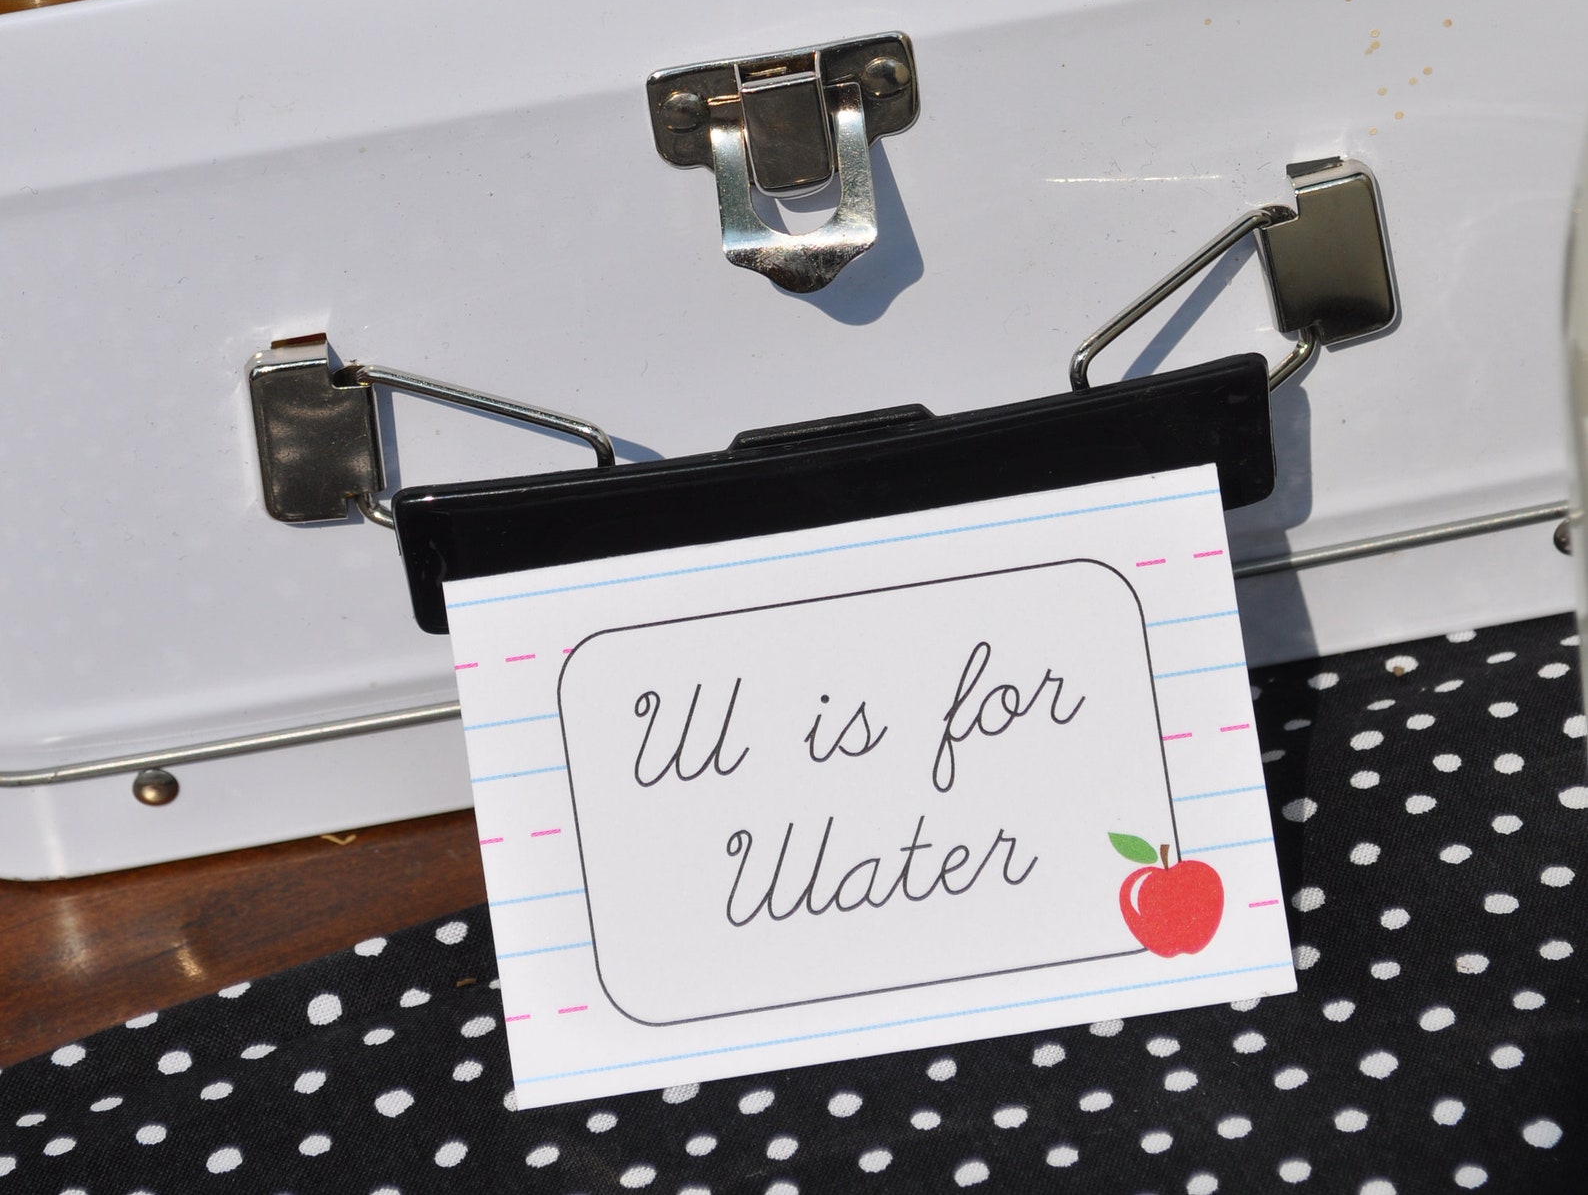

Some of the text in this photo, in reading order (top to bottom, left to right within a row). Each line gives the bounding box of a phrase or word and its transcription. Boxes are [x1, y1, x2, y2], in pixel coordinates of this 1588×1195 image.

[804, 694, 888, 763] is
[932, 641, 1086, 793] for
[726, 815, 1038, 927] Water
